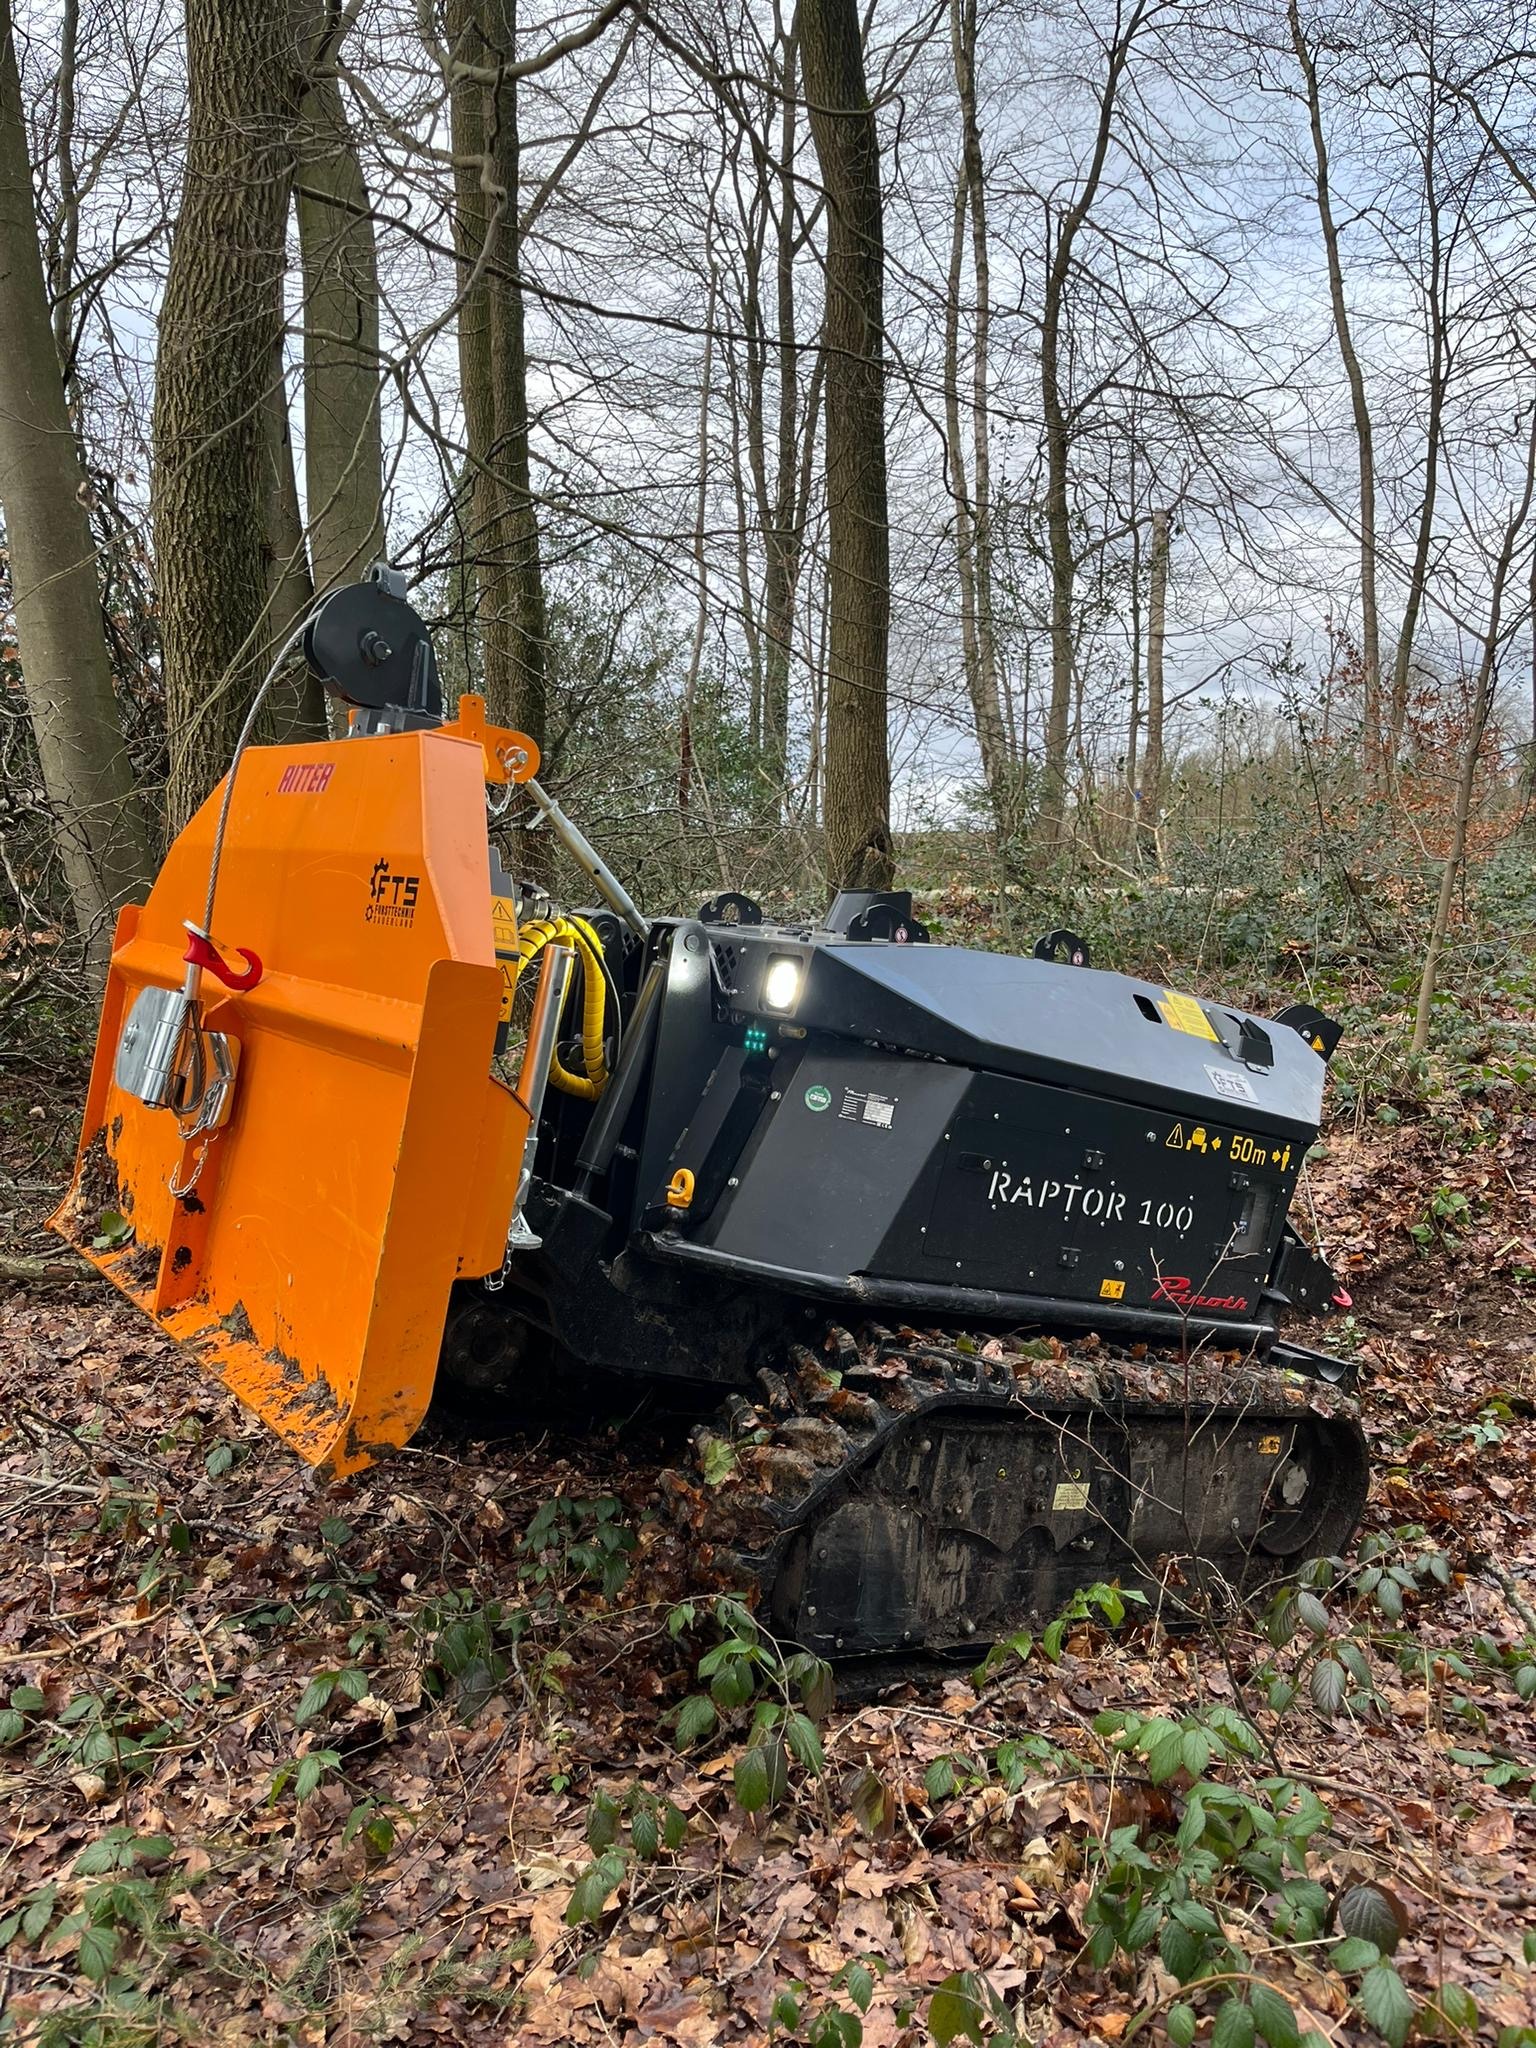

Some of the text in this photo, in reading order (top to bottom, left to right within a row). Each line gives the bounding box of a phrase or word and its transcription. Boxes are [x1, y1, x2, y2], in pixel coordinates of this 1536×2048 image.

[277, 764, 335, 792] RITTER
[376, 875, 420, 907] FTS
[1230, 1135, 1266, 1166] 50m
[987, 1171, 1194, 1232] RAPTOR 100
